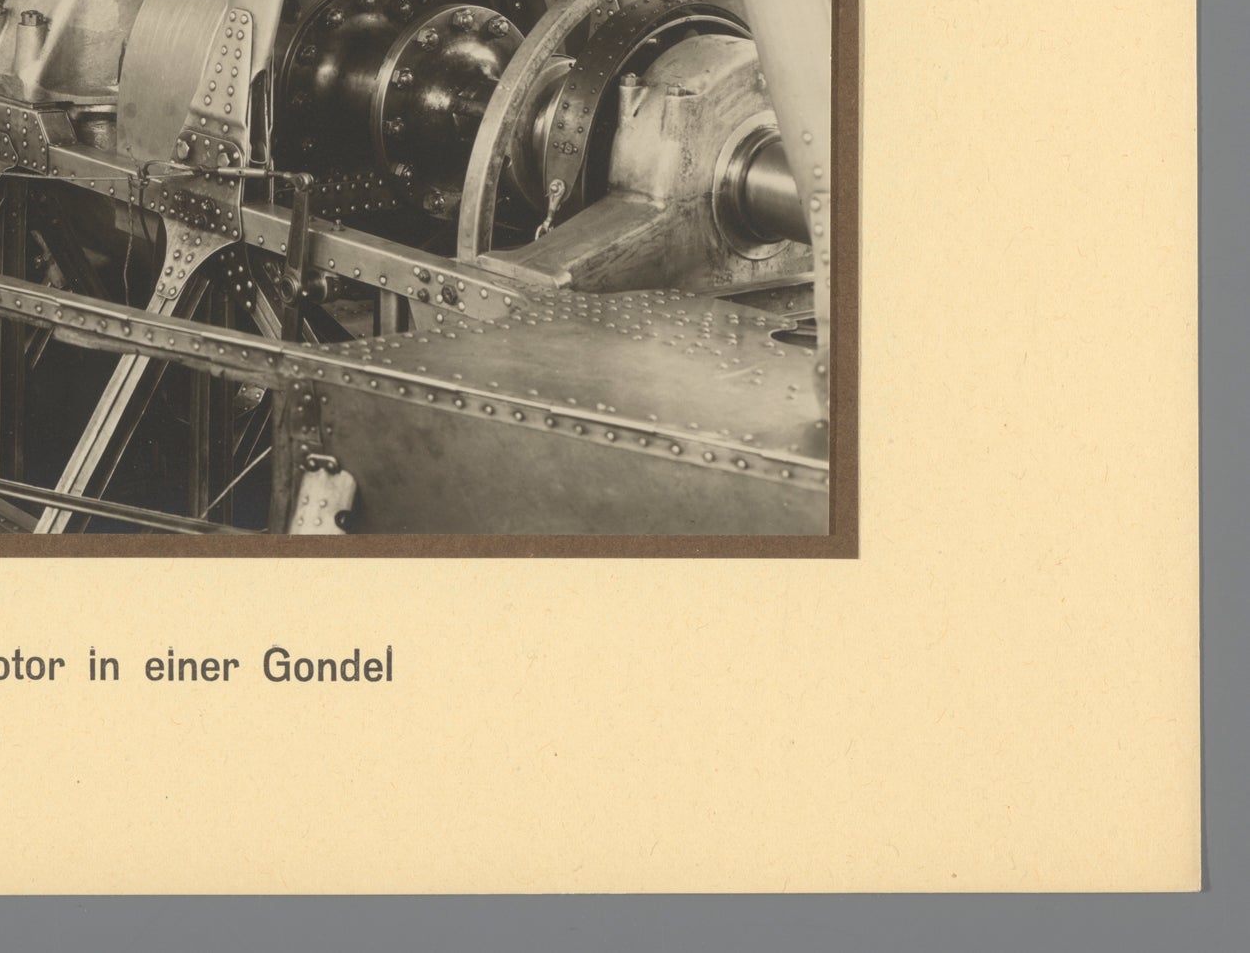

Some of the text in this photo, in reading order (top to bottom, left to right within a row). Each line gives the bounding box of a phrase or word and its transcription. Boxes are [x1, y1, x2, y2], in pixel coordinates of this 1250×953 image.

[89, 649, 119, 681] in
[145, 649, 240, 682] einer
[263, 645, 393, 683] Gondel
